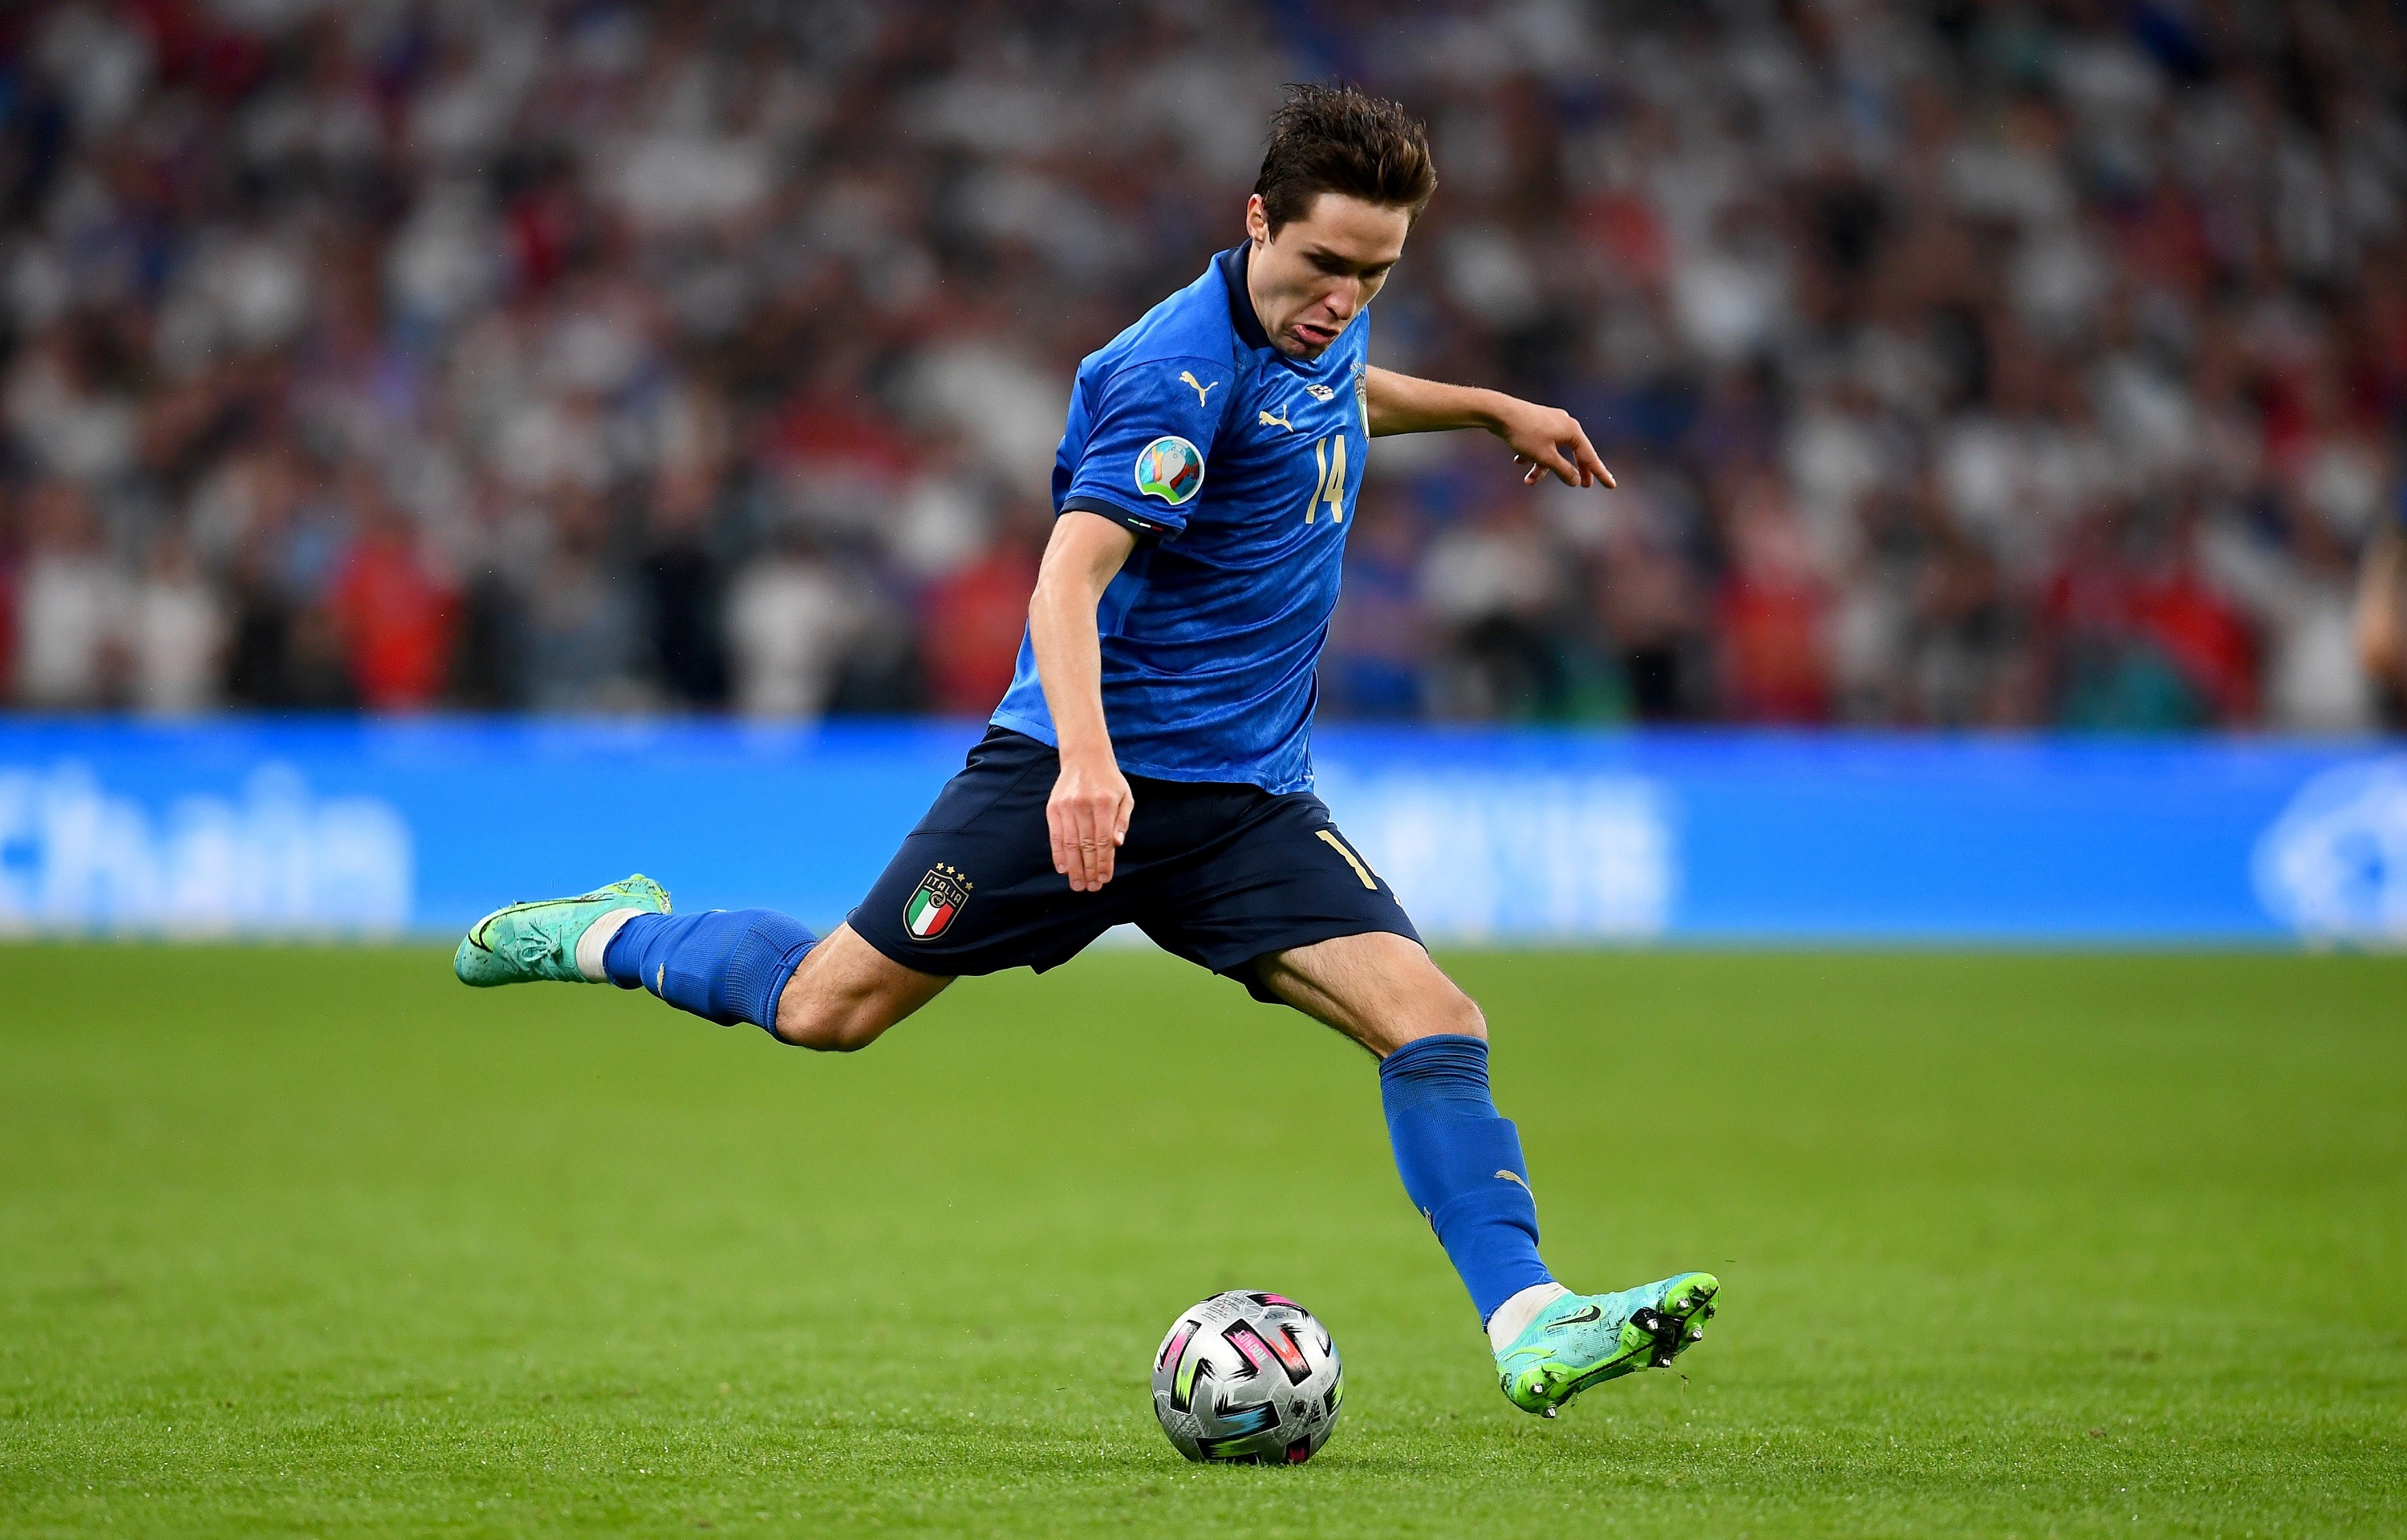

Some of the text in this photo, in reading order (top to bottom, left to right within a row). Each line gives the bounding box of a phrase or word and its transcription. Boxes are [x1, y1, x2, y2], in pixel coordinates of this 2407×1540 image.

[1305, 433, 1346, 525] 14
[926, 875, 963, 905] ITALIA
[1314, 829, 1401, 907] 1
[1233, 1329, 1268, 1364] LONDON
